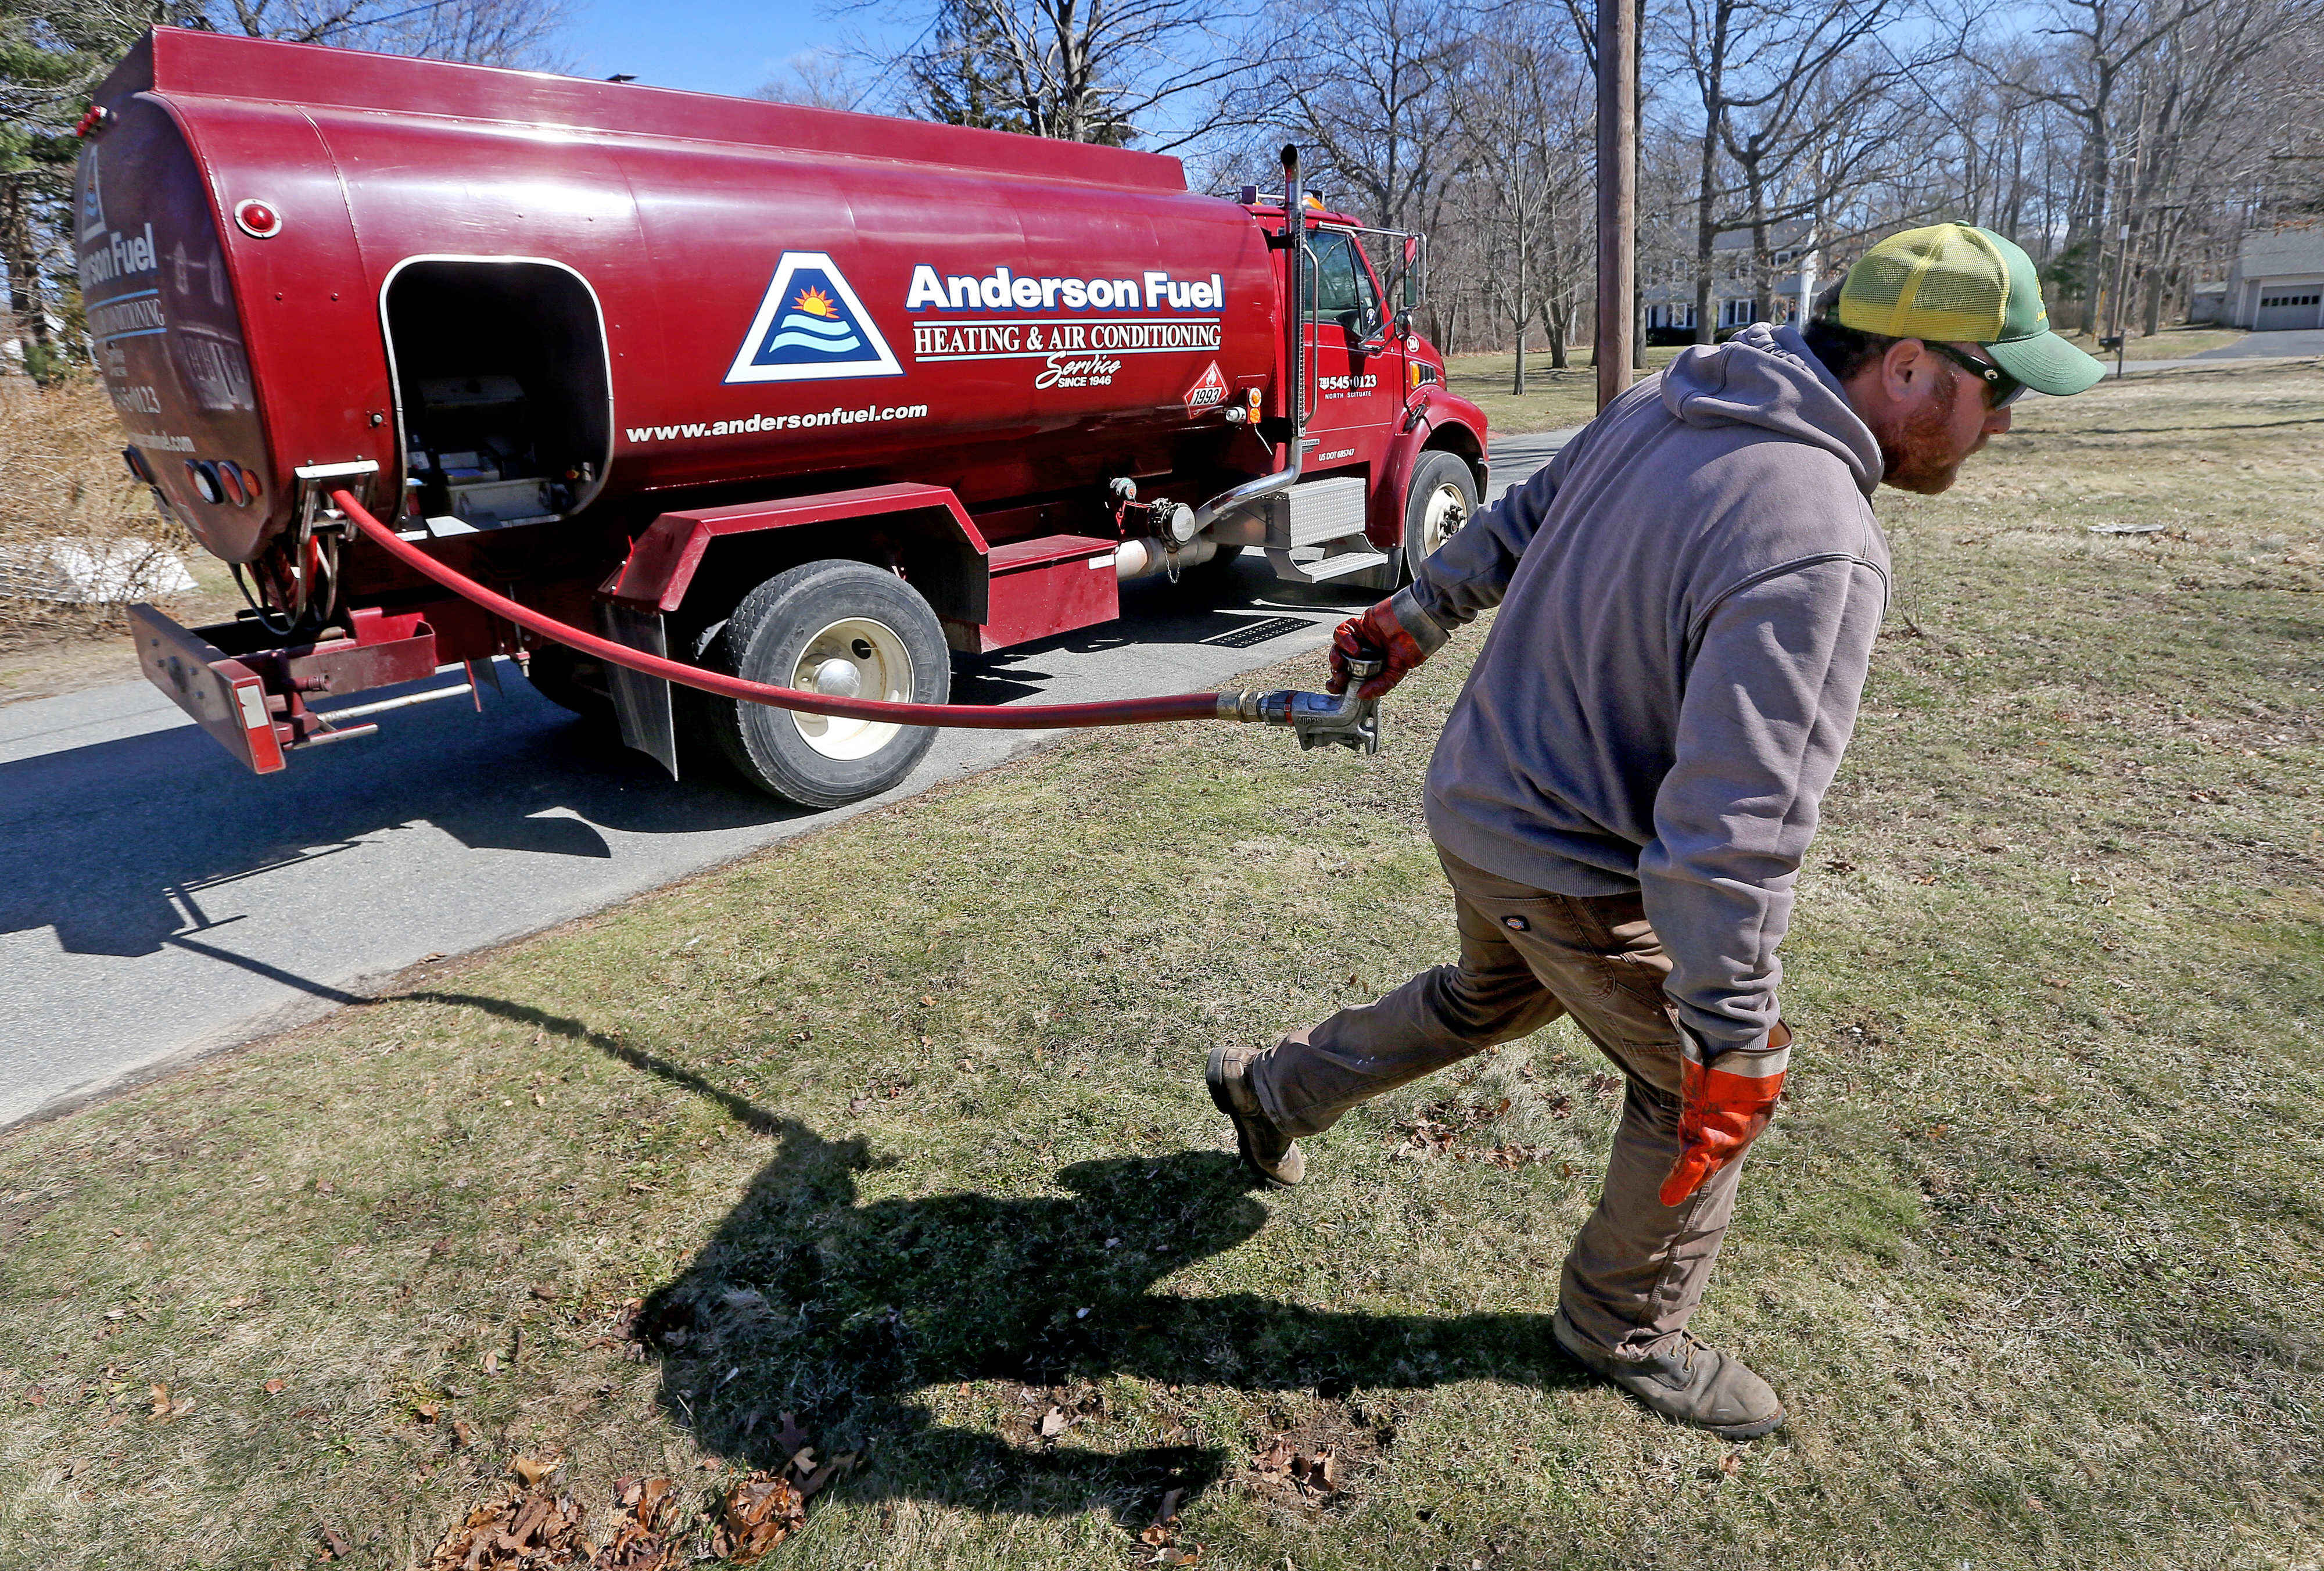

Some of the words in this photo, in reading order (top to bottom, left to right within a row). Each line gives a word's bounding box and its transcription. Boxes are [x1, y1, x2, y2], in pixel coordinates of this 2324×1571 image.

[110, 223, 158, 277] Fuel
[905, 264, 1142, 311] Anderson
[1143, 271, 1225, 311] Fuel
[913, 326, 1020, 354] HEATING
[1026, 325, 1043, 351] &
[1048, 325, 1087, 350] AIR
[1090, 324, 1222, 349] CONDITIONING
[1035, 350, 1122, 390] Service
[1057, 376, 1088, 388] SINCE
[1088, 375, 1112, 386] 1946
[1193, 388, 1220, 405] 1993
[626, 403, 928, 443] www.andersonfuel.com
[1318, 453, 1326, 462] US
[1326, 451, 1337, 461] DOT
